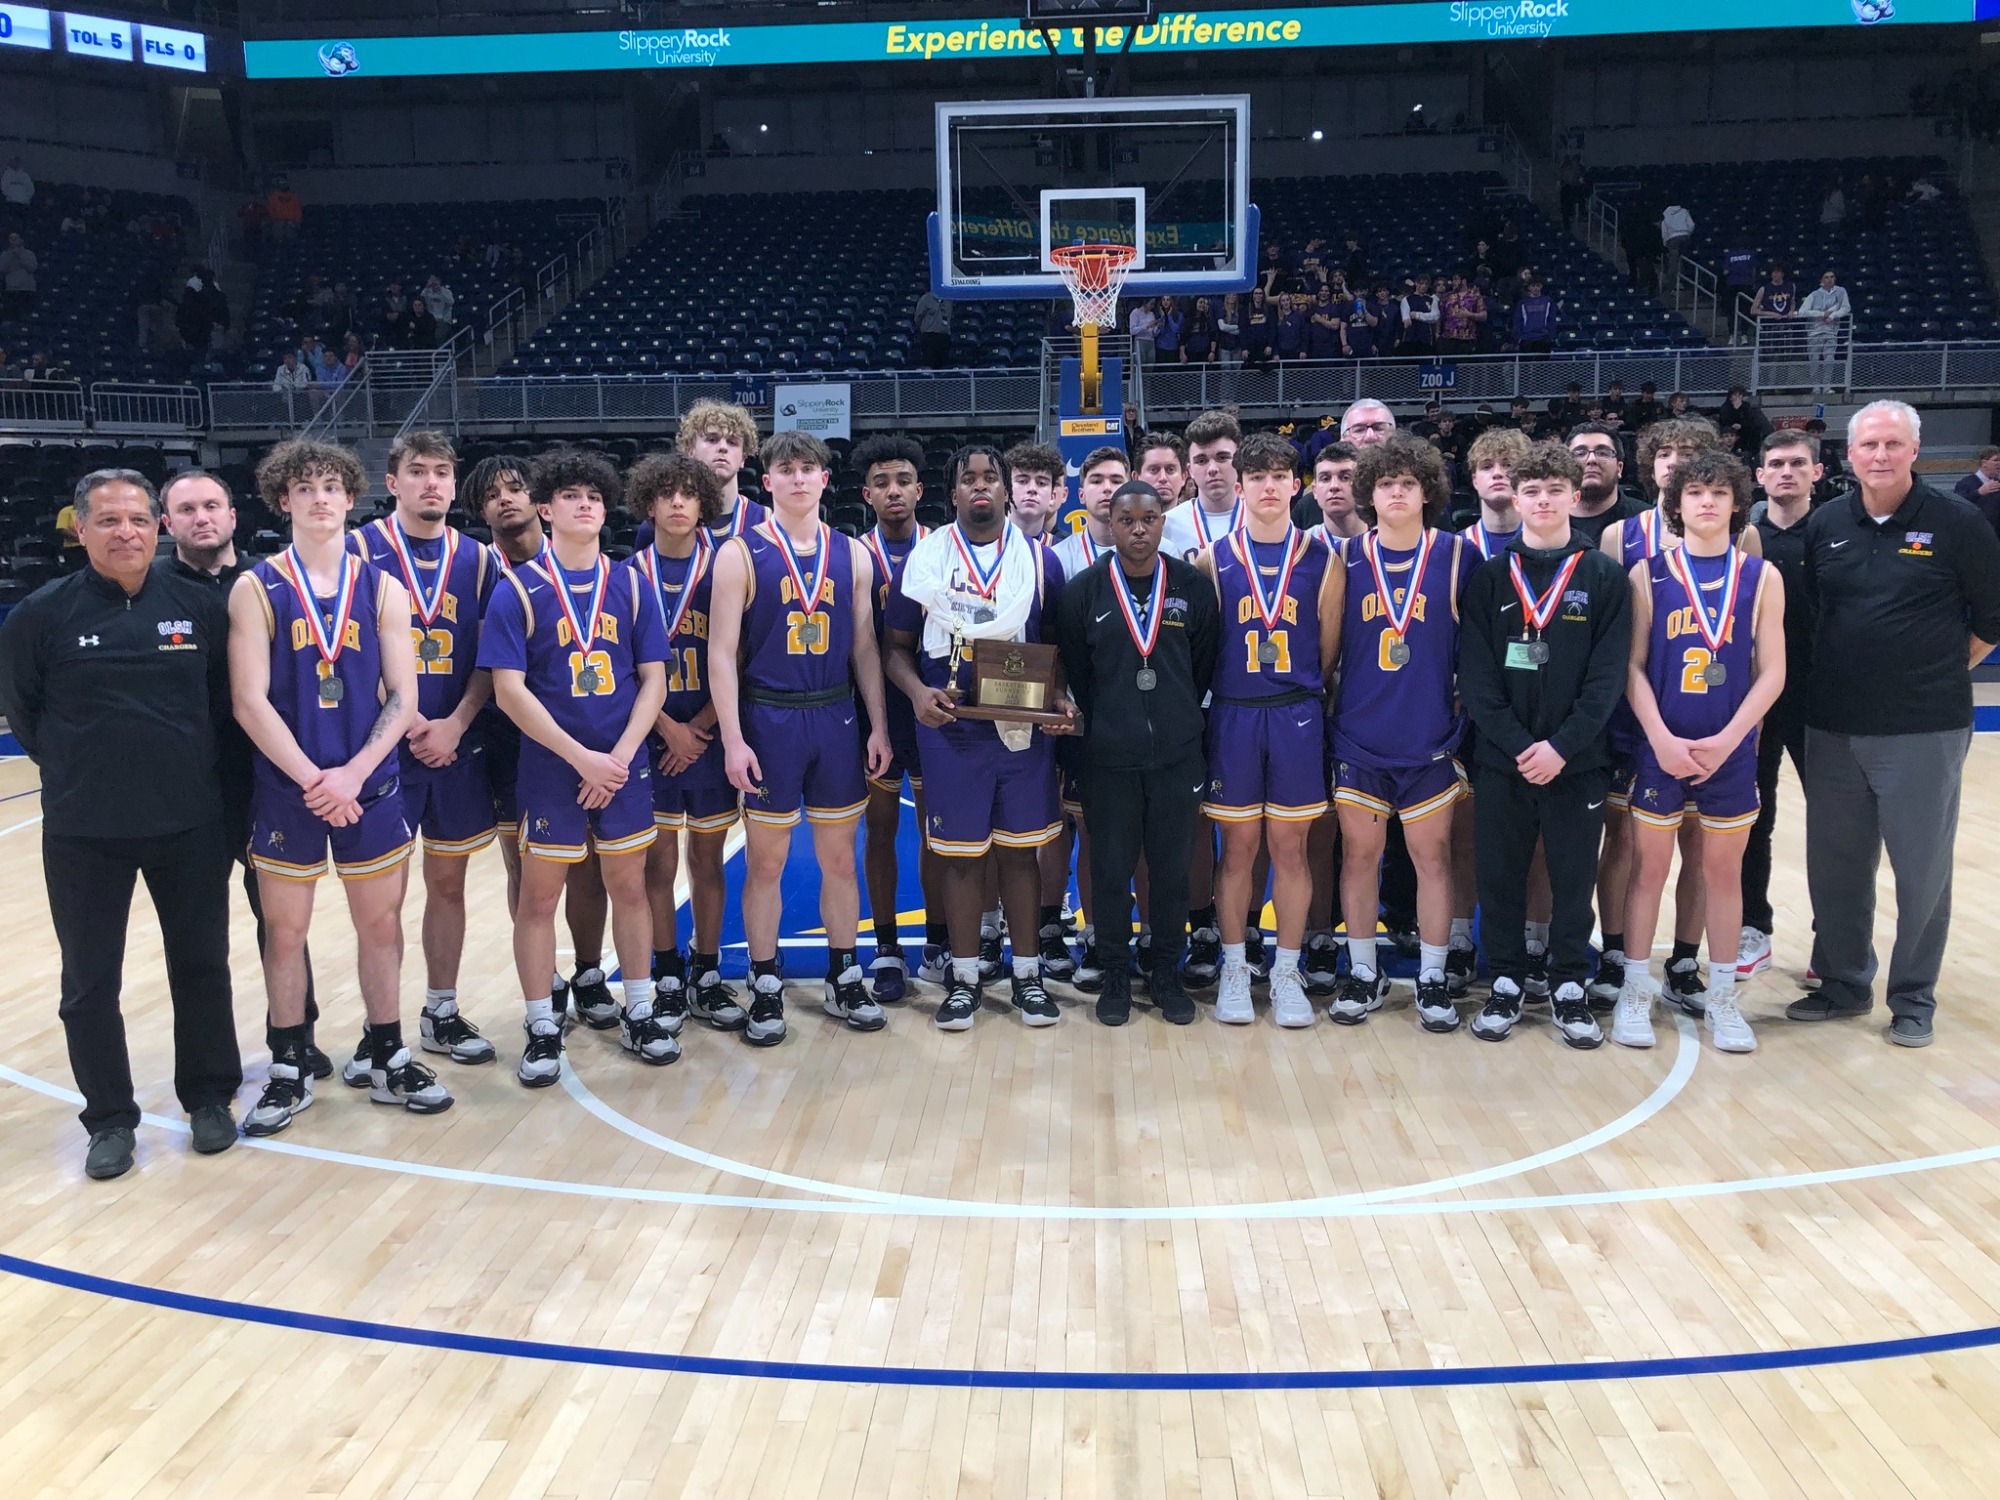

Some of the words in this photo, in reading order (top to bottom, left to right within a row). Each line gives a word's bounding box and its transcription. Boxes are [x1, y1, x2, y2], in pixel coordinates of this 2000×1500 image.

[1450, 0, 1569, 27] SlipperyRock
[71, 29, 103, 47] TOL
[111, 33, 122, 49] 5
[619, 28, 731, 55] SlipperyRock
[886, 22, 1061, 60] Experience
[1134, 13, 1302, 47] Difference
[1487, 19, 1552, 38] University
[145, 40, 175, 56] FLS
[184, 44, 195, 61] 0
[655, 49, 717, 66] University
[1421, 373, 1443, 388] ZOO
[1446, 371, 1454, 387] J
[1106, 422, 1119, 431] CAT
[157, 620, 193, 635] OLSH
[557, 611, 619, 648] OH
[787, 611, 830, 655] 20
[1667, 606, 1735, 644] OL
[1245, 630, 1292, 673] 14
[568, 650, 616, 698] 13
[1681, 647, 1712, 694] 2
